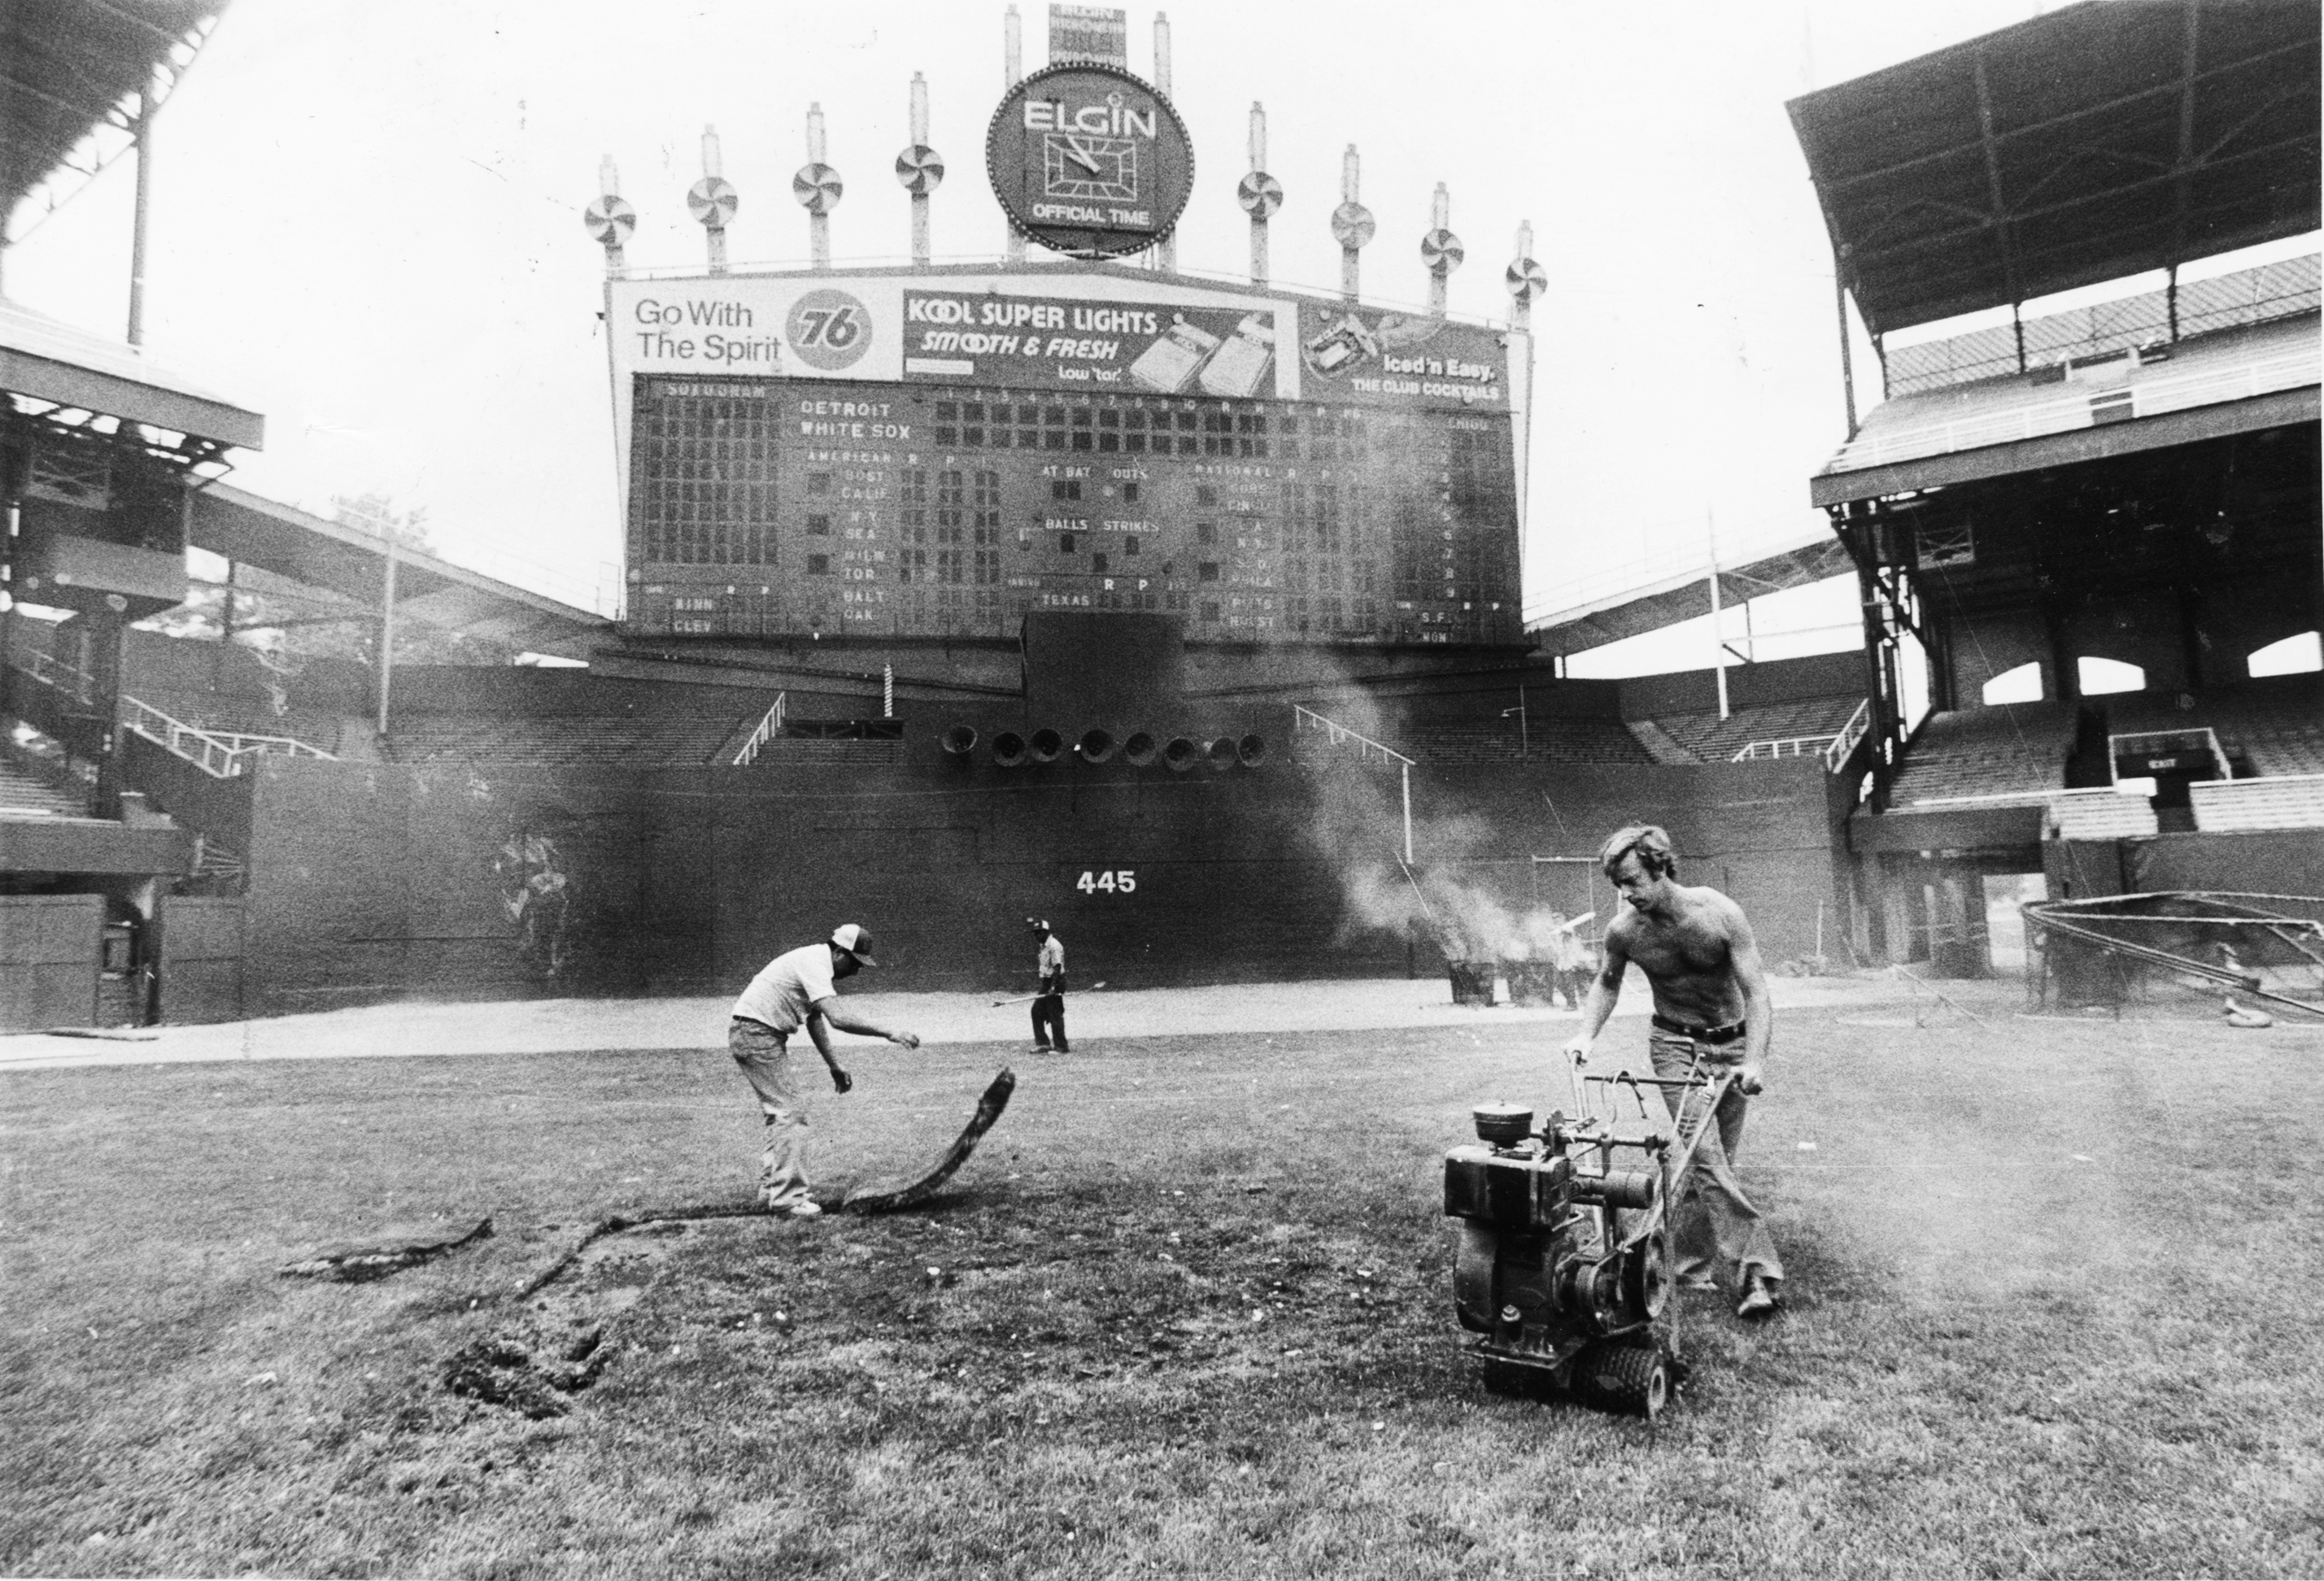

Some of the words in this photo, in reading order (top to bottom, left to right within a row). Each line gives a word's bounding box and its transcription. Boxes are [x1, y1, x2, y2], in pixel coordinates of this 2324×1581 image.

[1024, 92, 1156, 138] ELGIN
[1032, 203, 1105, 223] OFFICIAL
[1108, 208, 1149, 225] TIME
[635, 298, 682, 325] Go
[687, 300, 753, 327] With
[909, 298, 975, 325] KOOL
[981, 303, 1065, 329] SUPER
[800, 307, 858, 348] 76
[637, 331, 695, 359] The
[704, 333, 782, 366] Spirit
[921, 330, 1018, 354] SMOOTH
[1023, 337, 1040, 355] &
[1046, 338, 1119, 360] FRESH
[1058, 365, 1089, 381] Low
[1447, 359, 1495, 382] Easy.
[1352, 378, 1380, 392] THE
[1383, 380, 1420, 394] CLUB
[1423, 382, 1499, 399] COCKTAILS
[801, 400, 891, 418] DETROIT
[976, 390, 982, 401] 2
[1002, 390, 1009, 402] 3
[1028, 393, 1036, 403] 4
[1055, 393, 1062, 404] 5
[1082, 395, 1089, 405] 6
[1108, 395, 1115, 406] 7
[1161, 399, 1168, 410] 9
[1223, 402, 1230, 412] R
[801, 421, 863, 438] WHITE
[872, 424, 910, 439] SOX
[1042, 465, 1058, 477] AT
[1066, 466, 1091, 477] BAT
[1045, 518, 1088, 530] BALLS
[1103, 520, 1160, 532] STRIKES
[1105, 578, 1114, 590] R
[1139, 579, 1148, 590] P
[1043, 595, 1090, 606] TEXAS
[1077, 871, 1136, 894] 445
